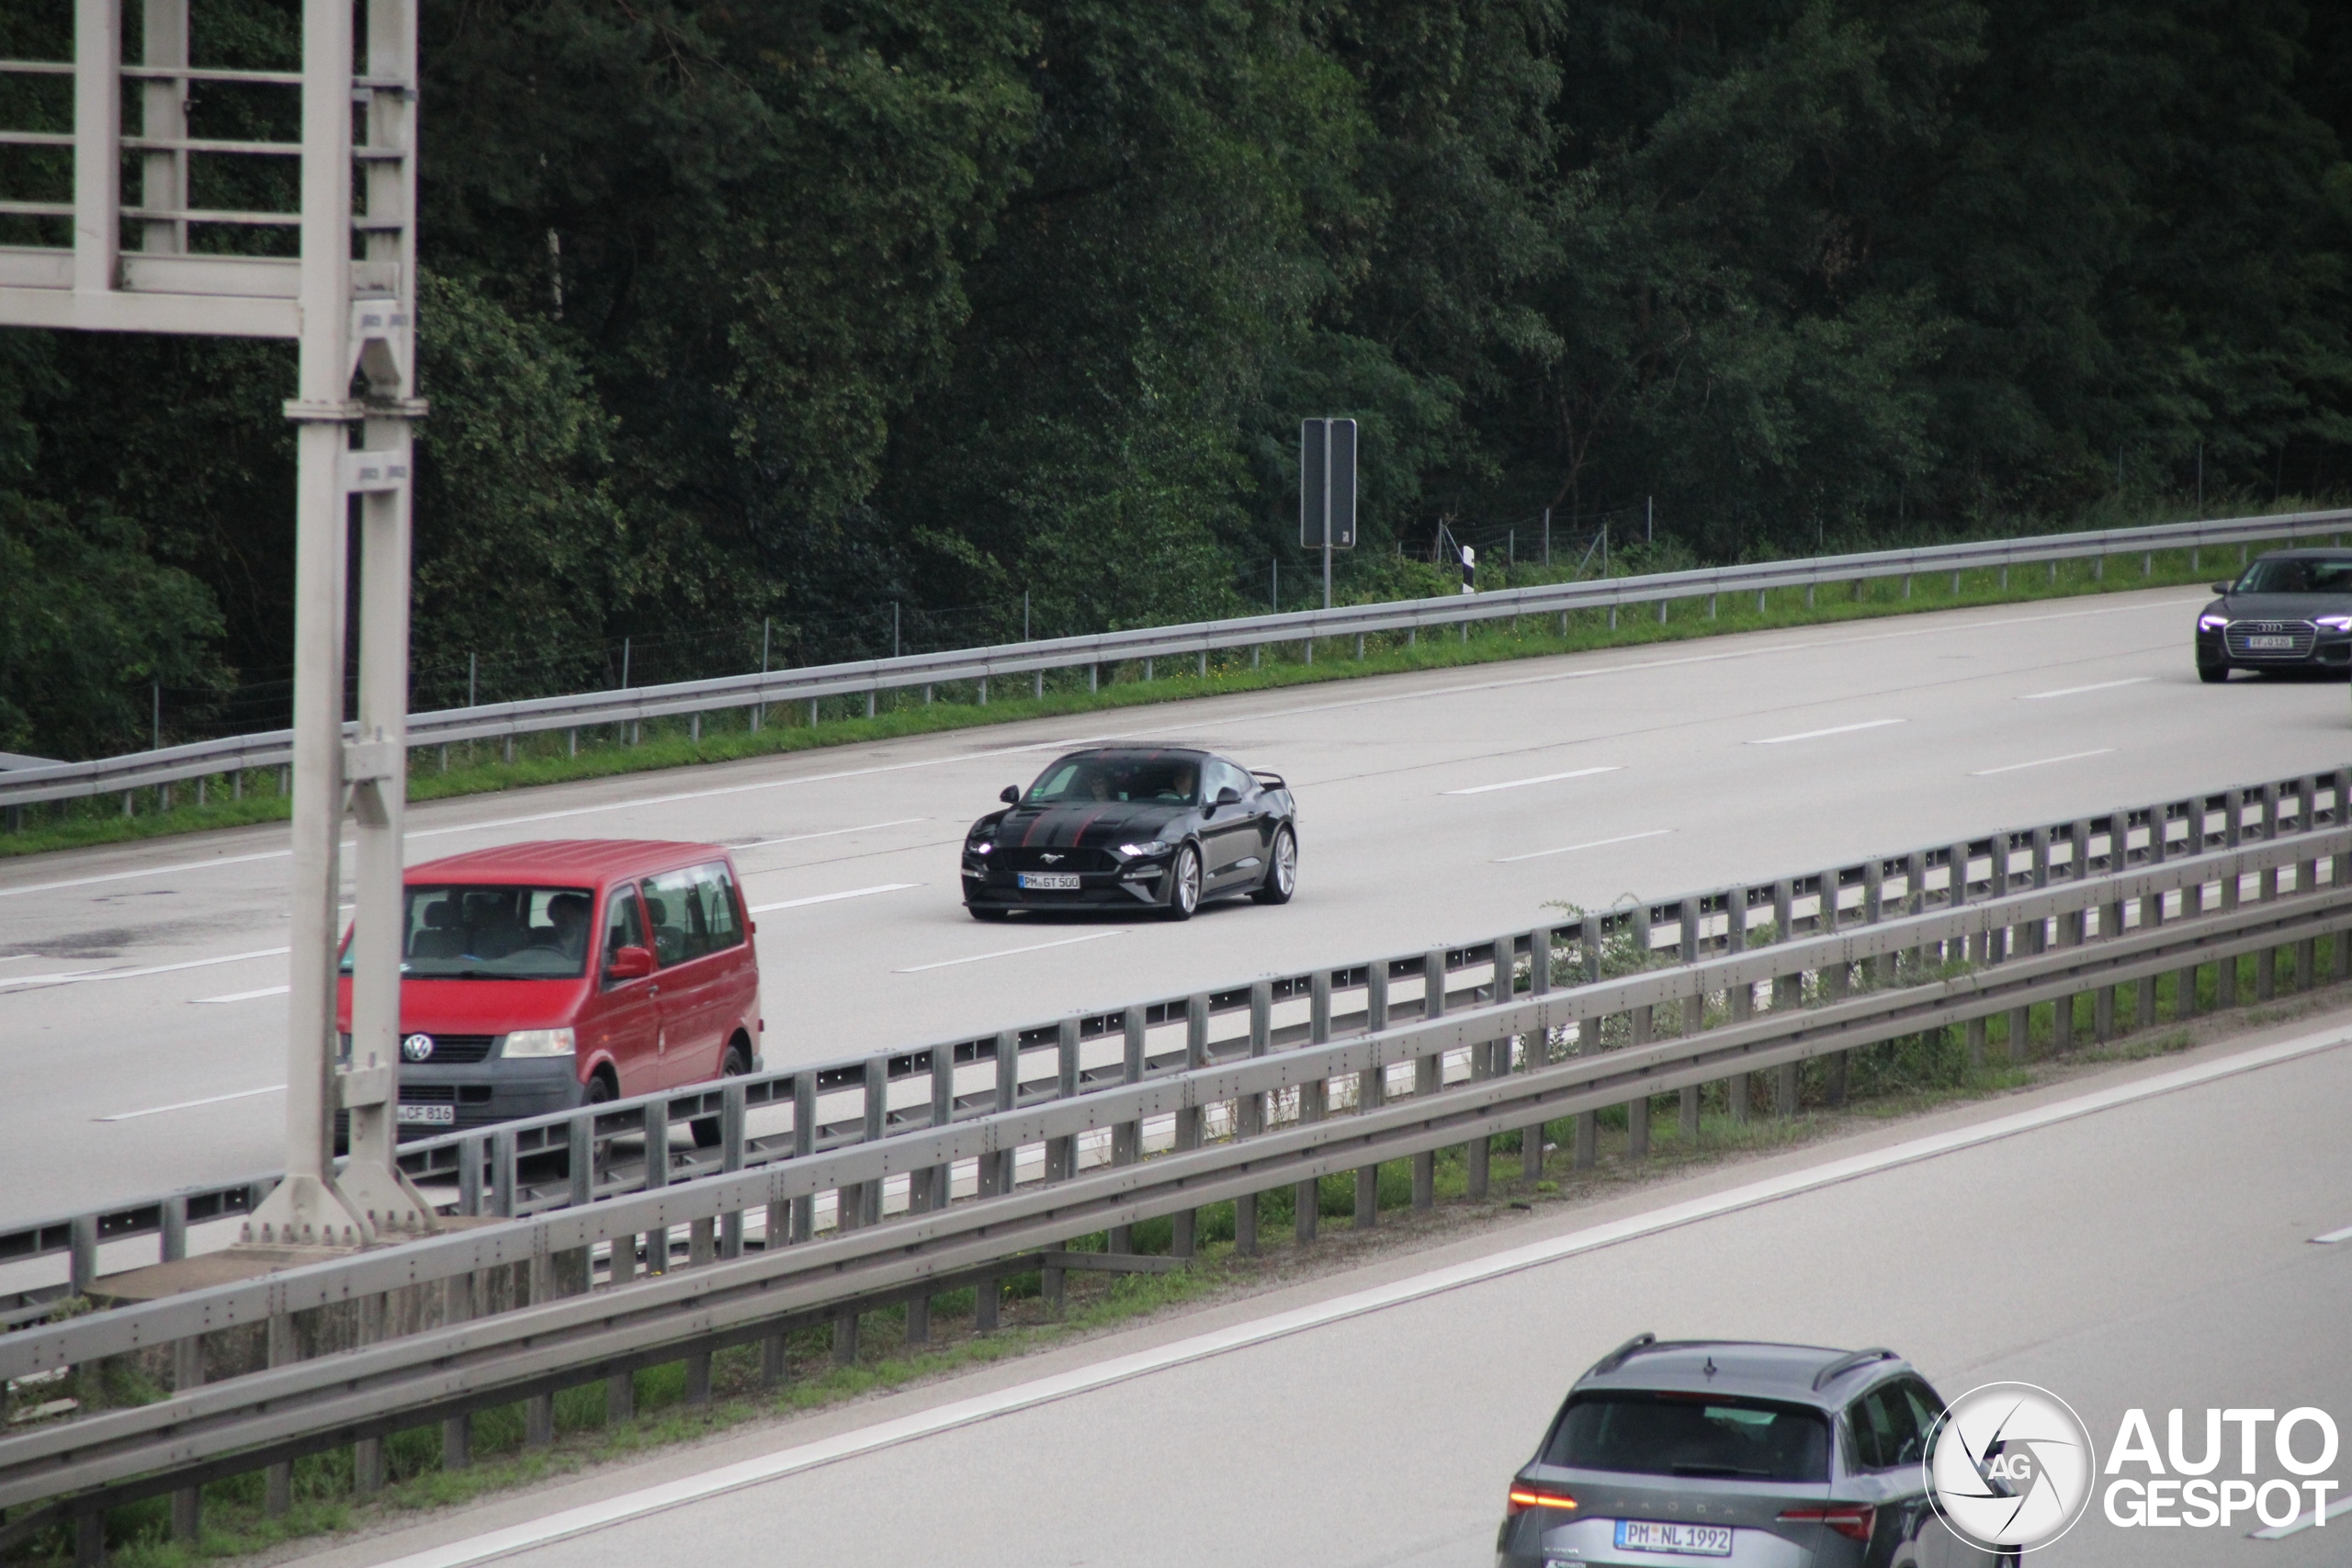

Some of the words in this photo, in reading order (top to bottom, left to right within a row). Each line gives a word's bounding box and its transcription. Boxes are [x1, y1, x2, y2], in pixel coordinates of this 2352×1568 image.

[1024, 876, 1037, 887] PM
[1044, 877, 1057, 887] GT
[1058, 877, 1079, 887] 500
[406, 1107, 423, 1120] CF
[426, 1107, 451, 1120] 816
[1628, 1524, 1650, 1543] PM
[1661, 1526, 1682, 1546] NL
[1686, 1528, 1728, 1550] 1992
